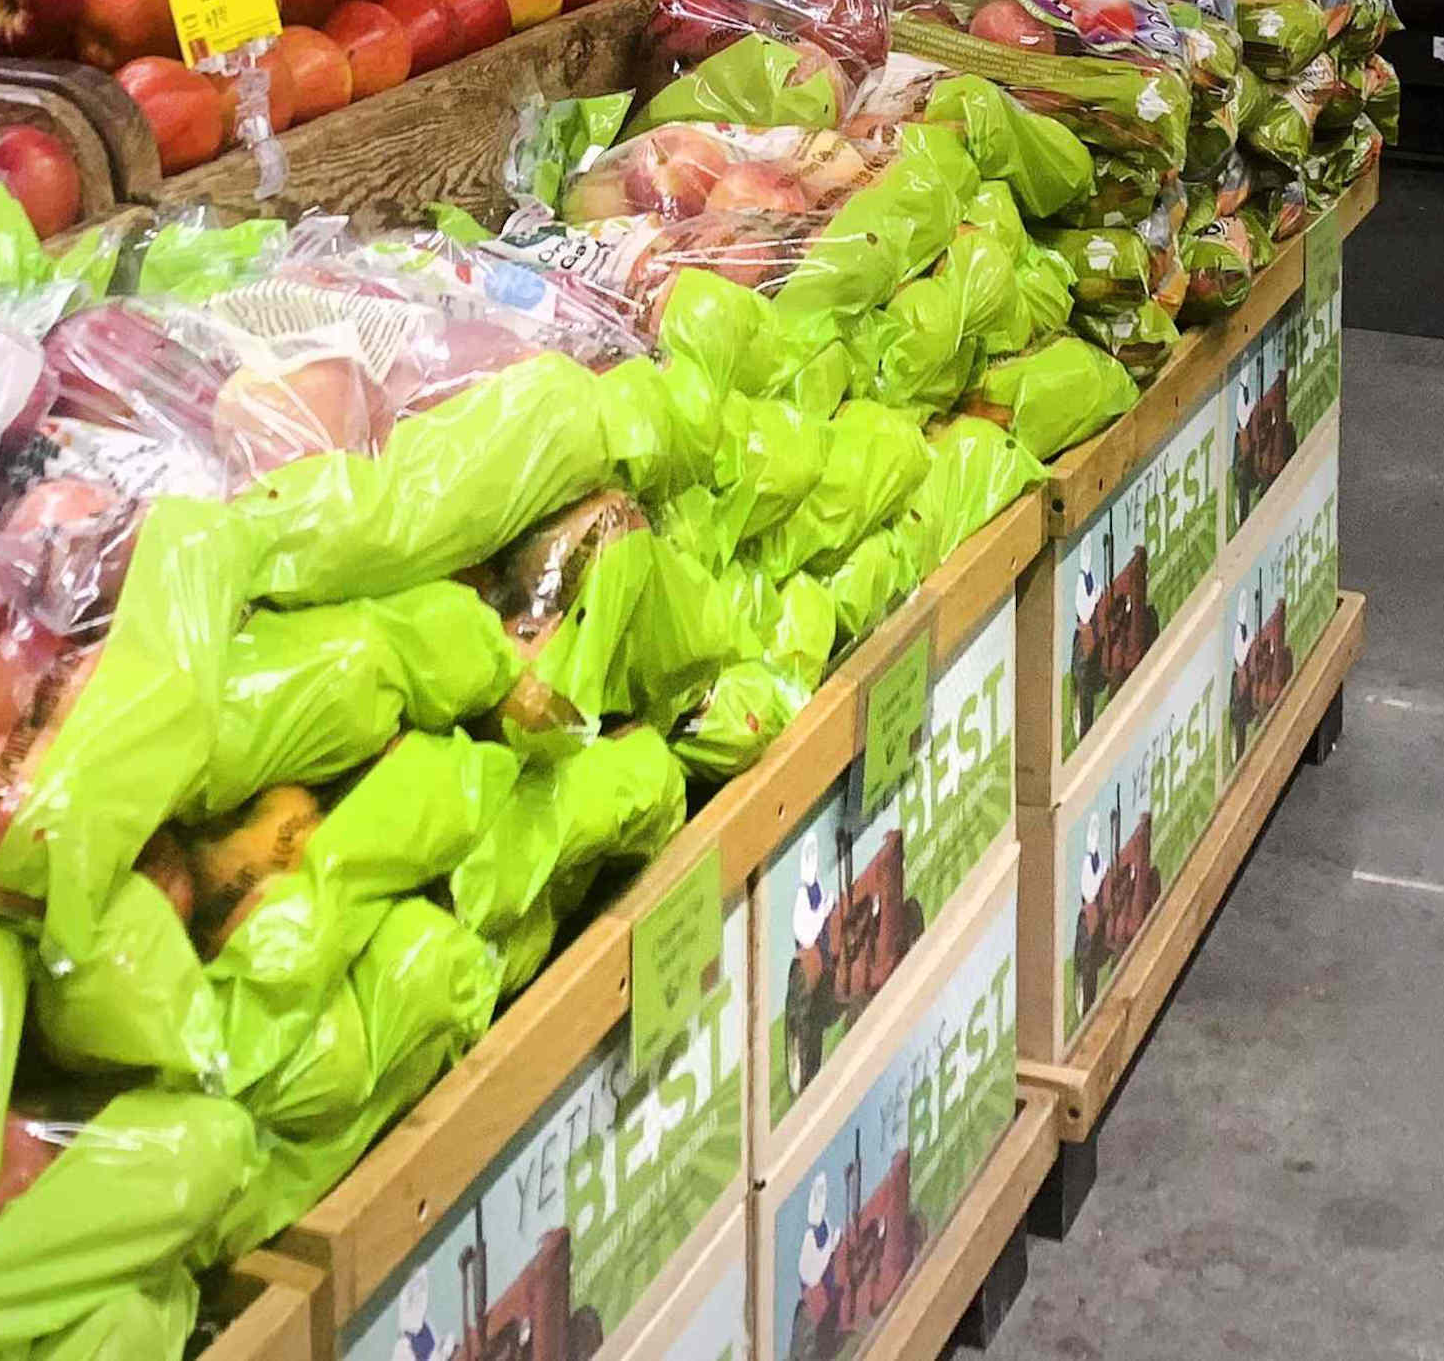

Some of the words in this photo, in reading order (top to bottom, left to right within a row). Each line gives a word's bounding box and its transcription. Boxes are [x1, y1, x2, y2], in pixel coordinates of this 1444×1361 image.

[1145, 427, 1215, 562] BEST
[898, 659, 1005, 845] BEST
[1150, 674, 1215, 820] BEST
[515, 1056, 624, 1232] YETI'S
[564, 977, 733, 1245] BEST
[909, 953, 1012, 1160] BEST
